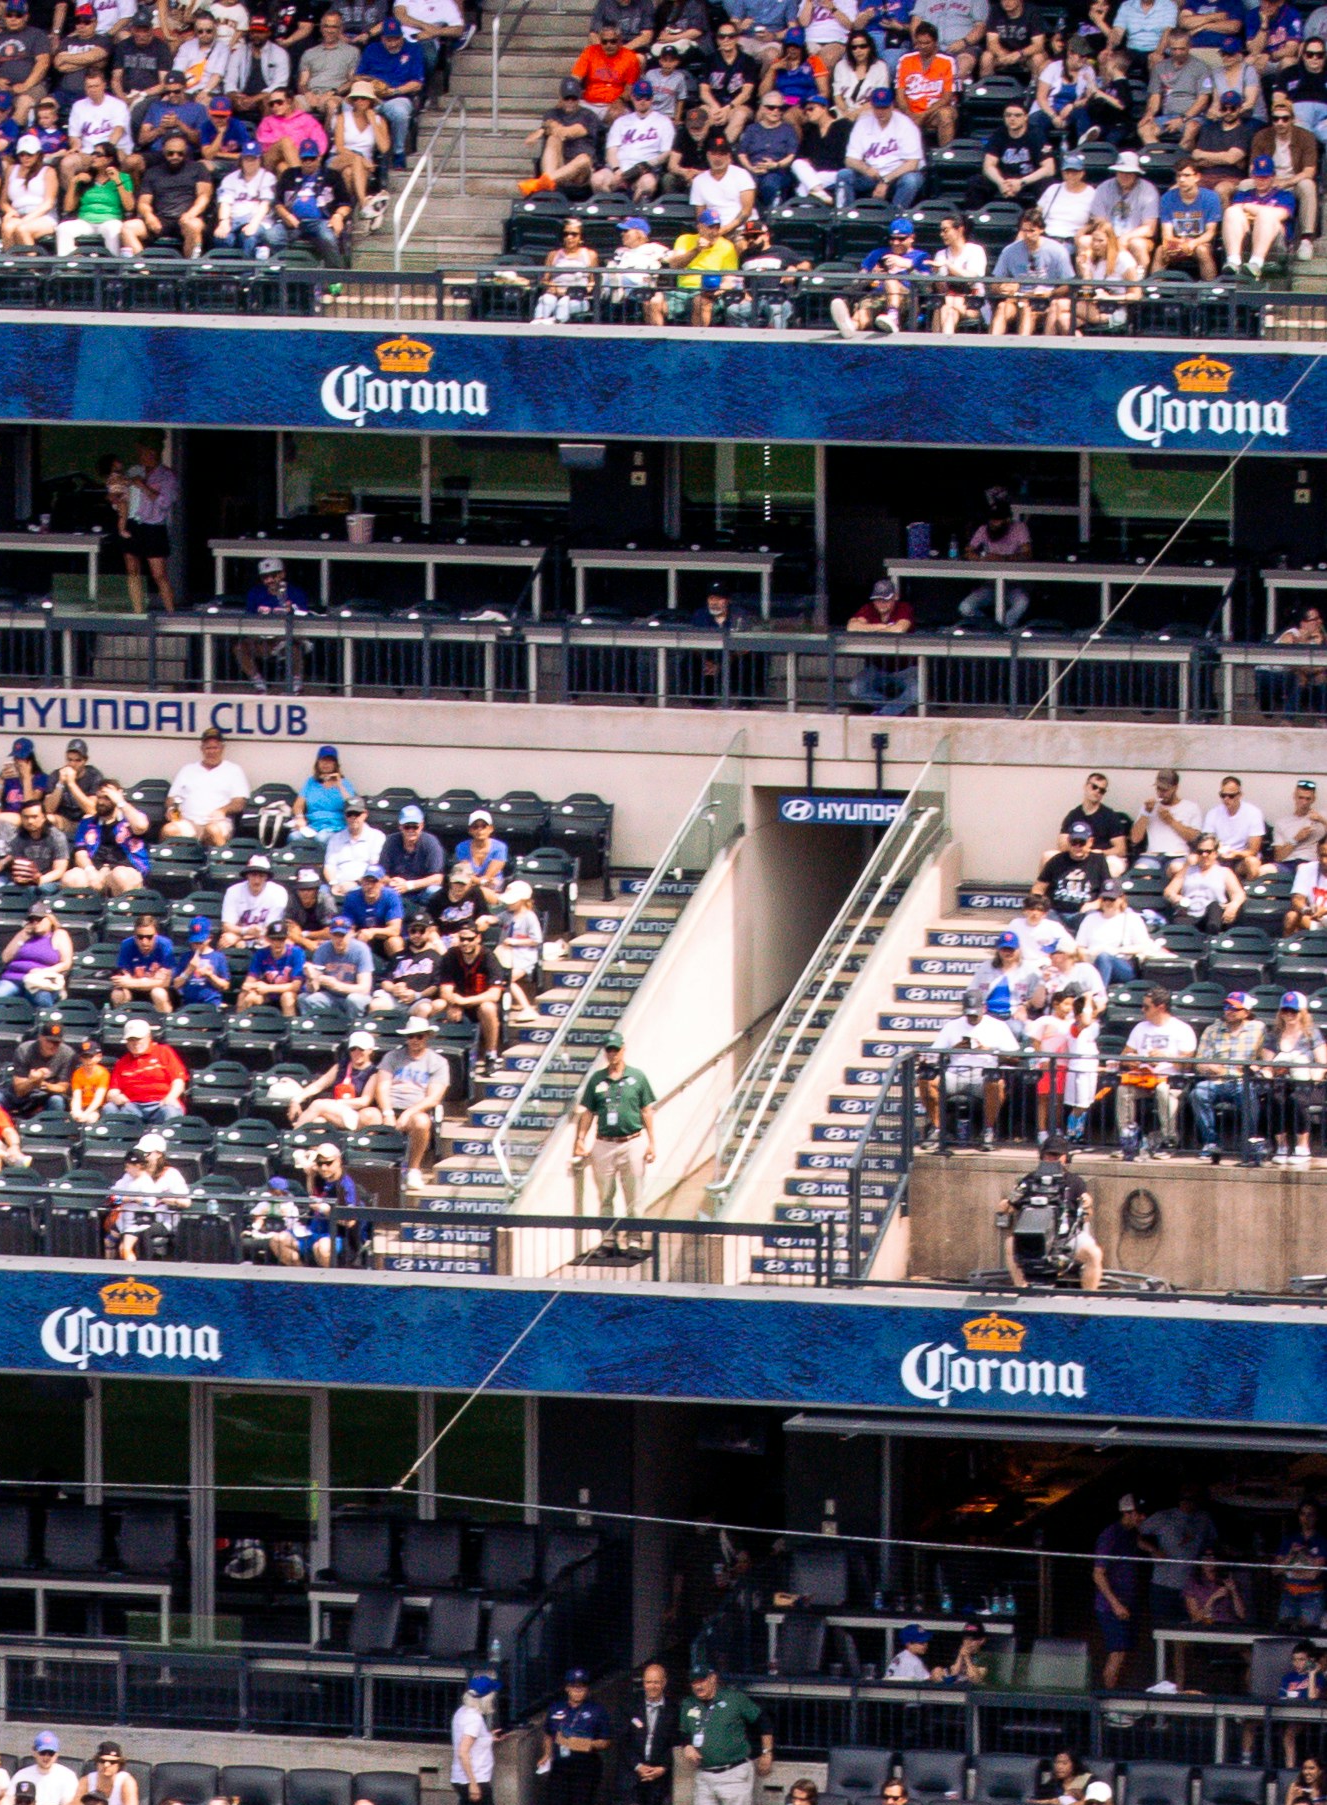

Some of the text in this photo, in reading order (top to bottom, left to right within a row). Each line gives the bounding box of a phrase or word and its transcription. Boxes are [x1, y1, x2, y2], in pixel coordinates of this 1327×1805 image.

[80, 120, 112, 137] Mets
[621, 124, 659, 145] Mets
[864, 139, 900, 161] Mets
[321, 366, 488, 426] Corona
[1118, 386, 1288, 447] Corona
[210, 703, 309, 736] CLUB
[42, 1307, 221, 1369] Corona
[902, 1343, 1086, 1406] Corona
